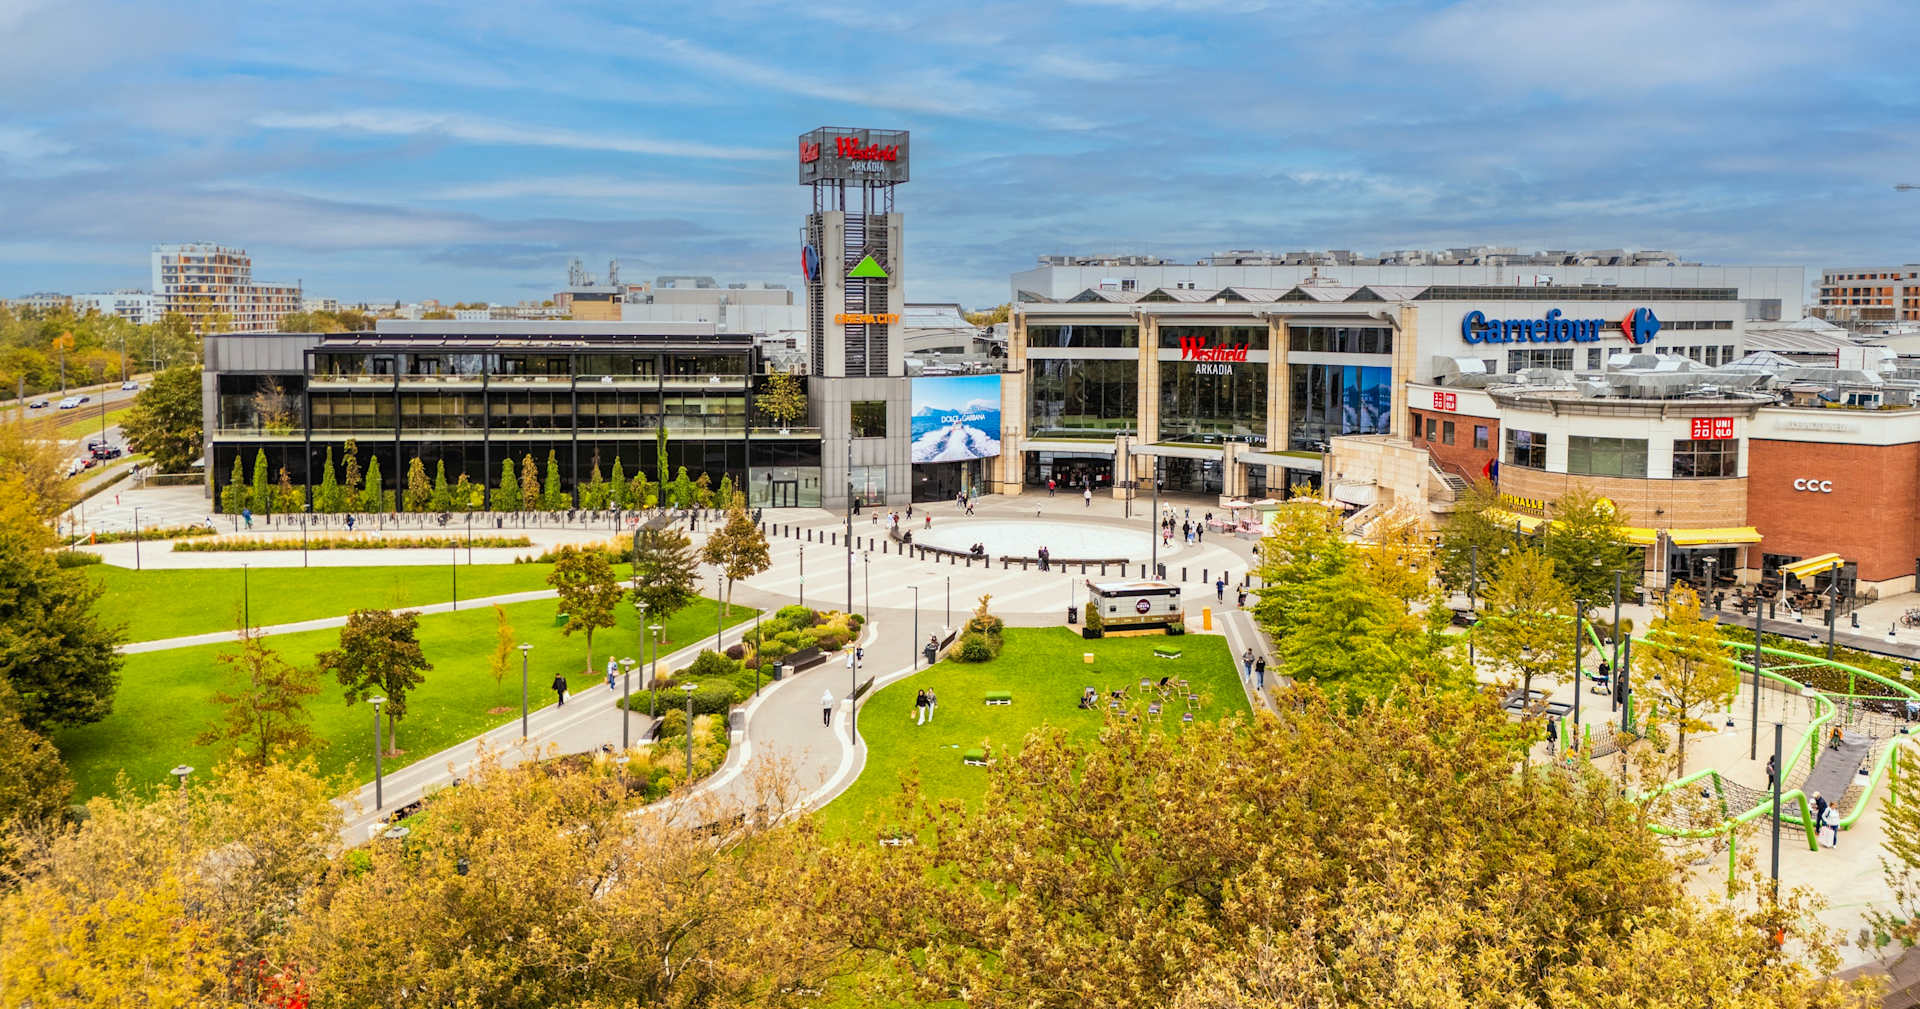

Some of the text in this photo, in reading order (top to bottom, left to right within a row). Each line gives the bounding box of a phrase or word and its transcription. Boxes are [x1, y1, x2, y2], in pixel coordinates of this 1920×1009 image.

[835, 137, 899, 161] Westfield
[851, 162, 885, 172] ARKADIA
[877, 313, 900, 325] CITY
[1462, 308, 1605, 344] Carrefour
[1178, 336, 1249, 362] Westfield
[1195, 364, 1233, 375] ARKADIA
[1716, 420, 1731, 428] UNI
[1715, 429, 1732, 438] QLO
[1793, 478, 1833, 493] CCC
